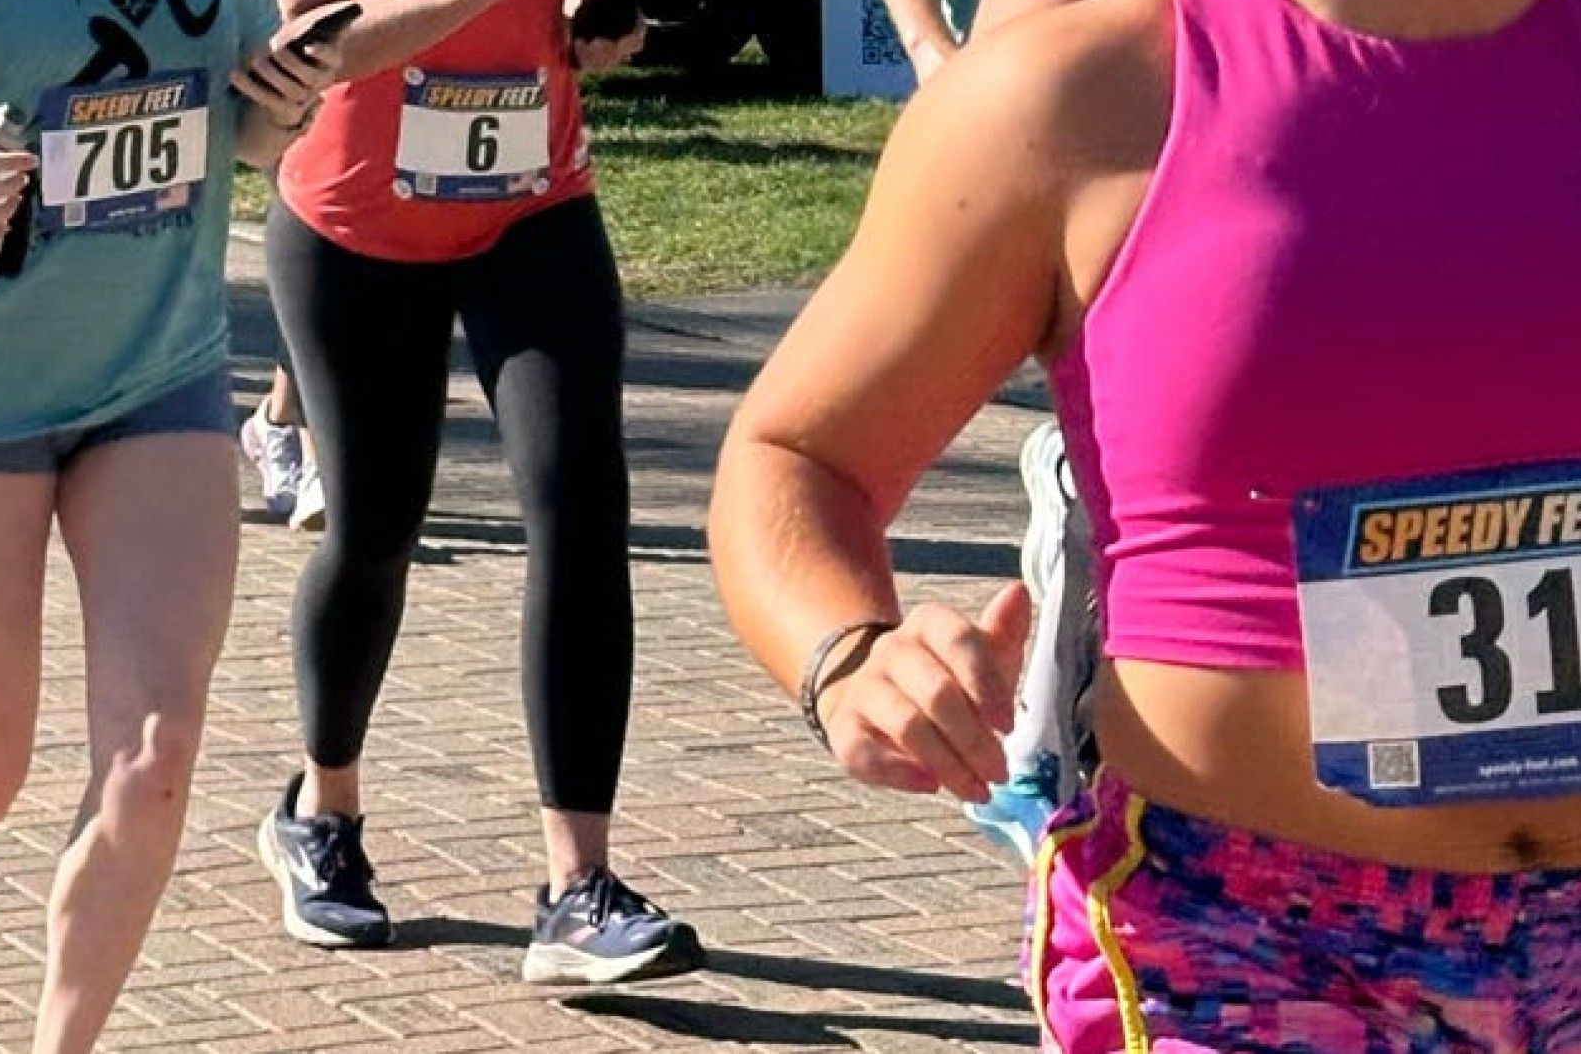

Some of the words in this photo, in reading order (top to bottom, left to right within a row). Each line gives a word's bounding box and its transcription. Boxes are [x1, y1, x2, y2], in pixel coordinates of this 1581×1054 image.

[72, 94, 142, 123] SPEEDY
[143, 84, 186, 114] FEET
[428, 86, 499, 107] SPEEDY
[499, 86, 541, 107] FEET
[75, 117, 181, 199] 705
[466, 115, 499, 172] 6
[1358, 498, 1533, 565] SPEEDY
[1537, 493, 1581, 545] FE
[1428, 567, 1581, 724] 31
